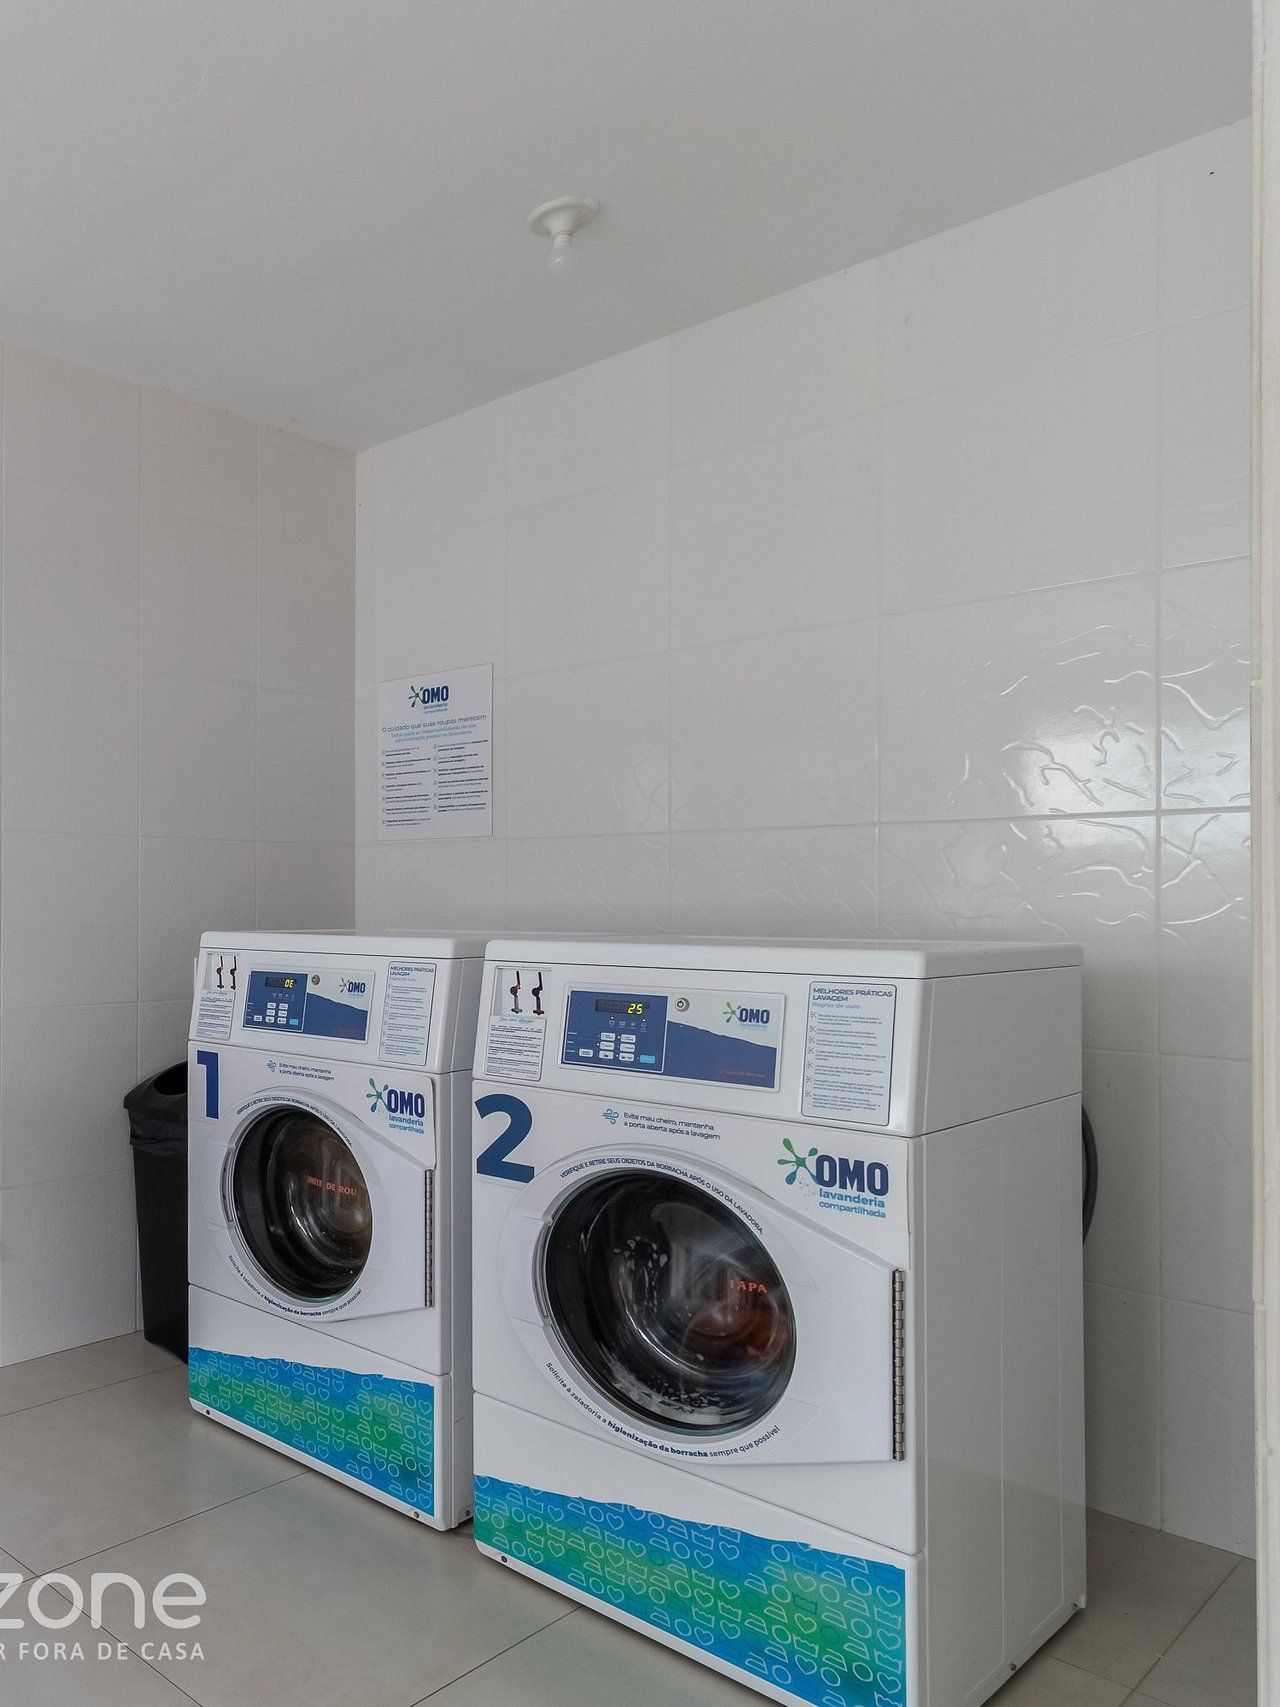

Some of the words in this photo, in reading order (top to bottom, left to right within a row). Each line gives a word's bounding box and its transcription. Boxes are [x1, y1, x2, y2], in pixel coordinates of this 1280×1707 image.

[421, 685, 449, 704] OMO
[347, 981, 366, 994] OMO
[812, 987, 854, 996] MELHORES
[855, 989, 893, 997] PRÁTICAS
[627, 1003, 643, 1014] 25
[738, 1007, 770, 1024] OMO
[196, 1049, 219, 1120] 1
[386, 1088, 425, 1119] OMO
[388, 1113, 424, 1127] lavanderia
[623, 1112, 639, 1120] Evite
[678, 1121, 714, 1131] mantenha
[473, 1093, 536, 1184] 2
[629, 1121, 645, 1129] porta
[646, 1124, 668, 1132] aberta
[668, 1127, 684, 1135] após
[690, 1130, 721, 1140] lavagem
[646, 1160, 655, 1168] DA
[711, 1185, 724, 1197] USO
[724, 1194, 733, 1204] DA
[815, 1154, 890, 1197] OMO
[818, 1187, 886, 1208] lavanderia
[819, 1200, 887, 1219] compartilhada
[546, 1362, 567, 1388] Solicite
[571, 1392, 602, 1420] zeladoria
[607, 1420, 658, 1449] higienização
[658, 1443, 670, 1453] da
[670, 1447, 708, 1458] borracha
[709, 1447, 739, 1458] sempre
[739, 1442, 754, 1452] que
[753, 1424, 781, 1447] possível
